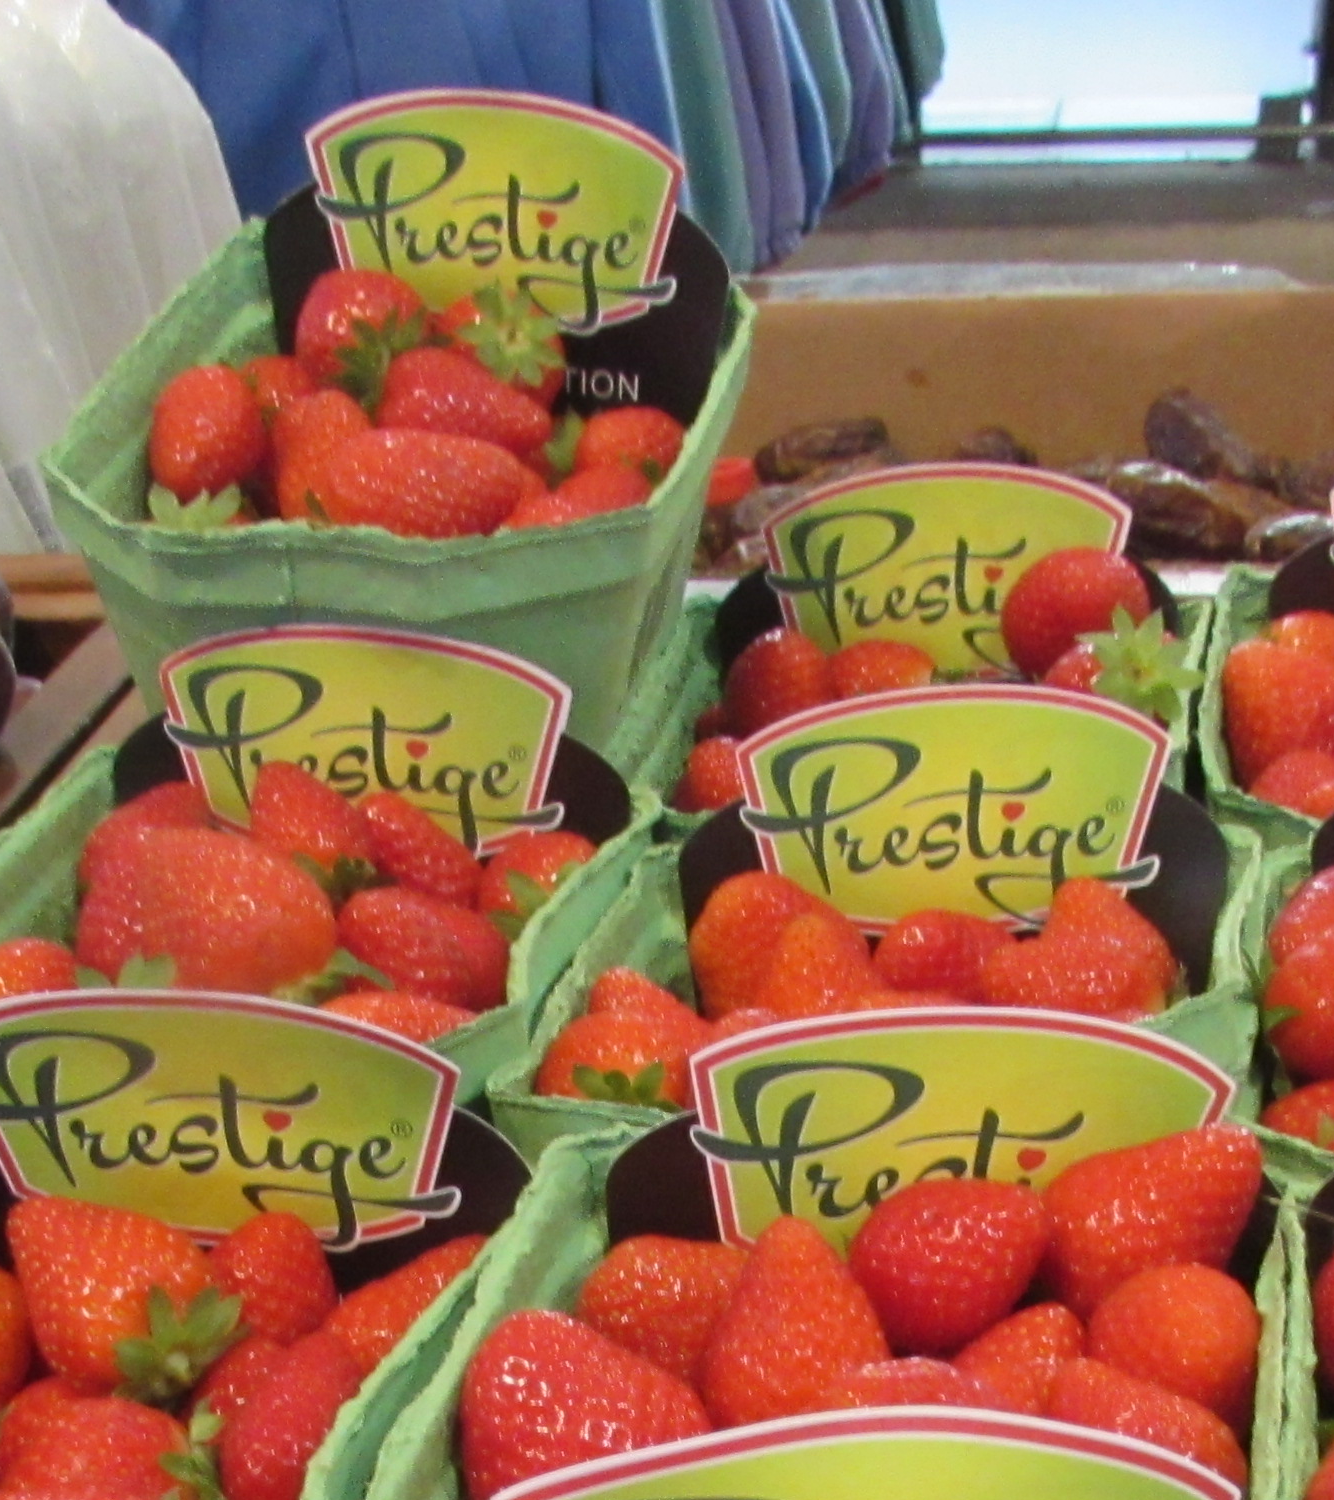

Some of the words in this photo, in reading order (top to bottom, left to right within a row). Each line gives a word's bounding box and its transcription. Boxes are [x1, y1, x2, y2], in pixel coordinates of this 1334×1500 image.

[318, 131, 675, 328] Prestige
[768, 508, 1027, 676] Presti
[741, 736, 1158, 925] Prestige
